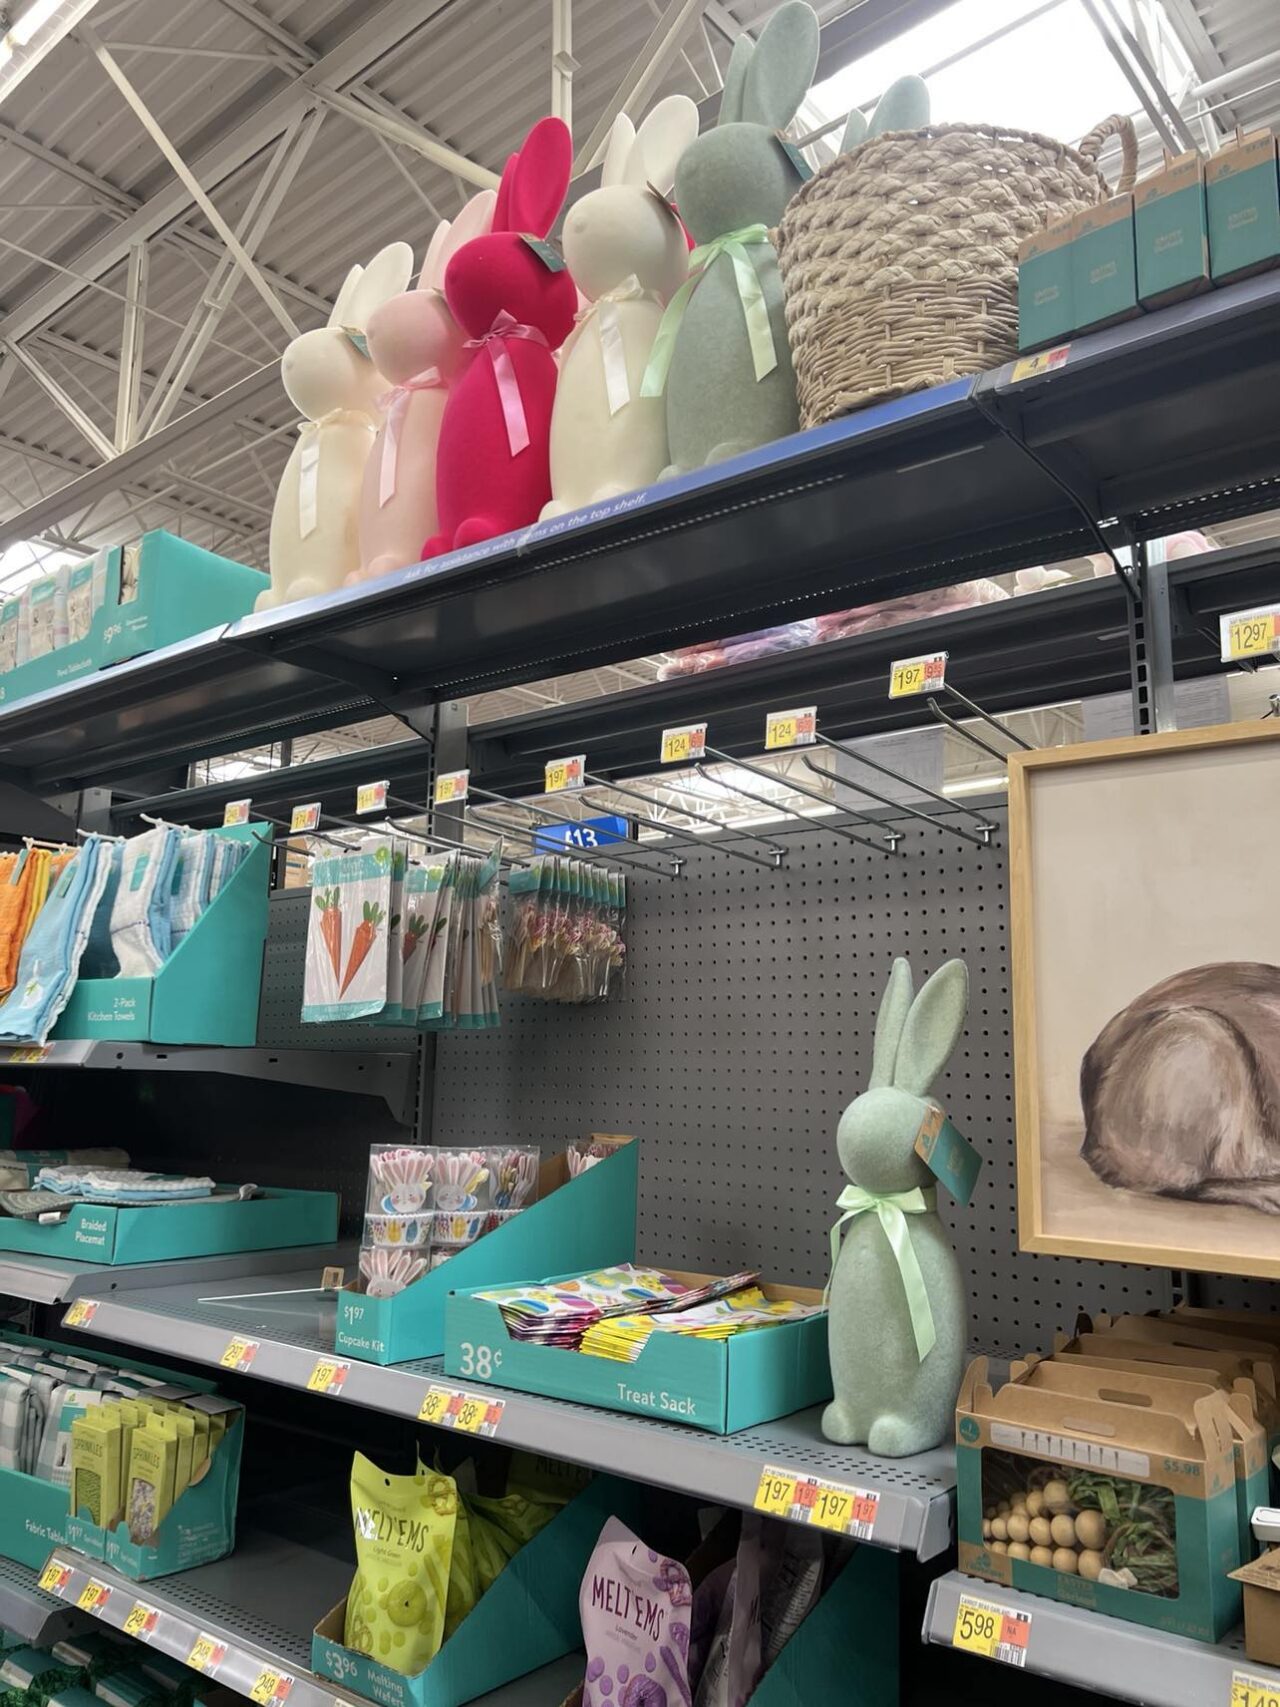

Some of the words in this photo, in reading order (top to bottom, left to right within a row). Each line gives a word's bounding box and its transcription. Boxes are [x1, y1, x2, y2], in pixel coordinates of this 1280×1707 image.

[549, 521, 565, 533] on
[567, 513, 588, 527] the
[590, 505, 612, 520] top
[113, 997, 136, 1008] 2-Pack
[87, 1010, 112, 1021] Kitchen
[113, 1010, 136, 1021] Towels
[81, 1218, 107, 1231] Braided
[75, 1231, 105, 1246] Placemat
[338, 1331, 370, 1350] Cupcake
[371, 1340, 385, 1352] Kit
[459, 1341, 503, 1379] 38¢
[617, 1383, 656, 1407] Treat
[660, 1392, 696, 1415] Sack
[25, 1519, 46, 1538] Fabric
[591, 1574, 665, 1642] MELT'EMS
[367, 1669, 403, 1697] Melting
